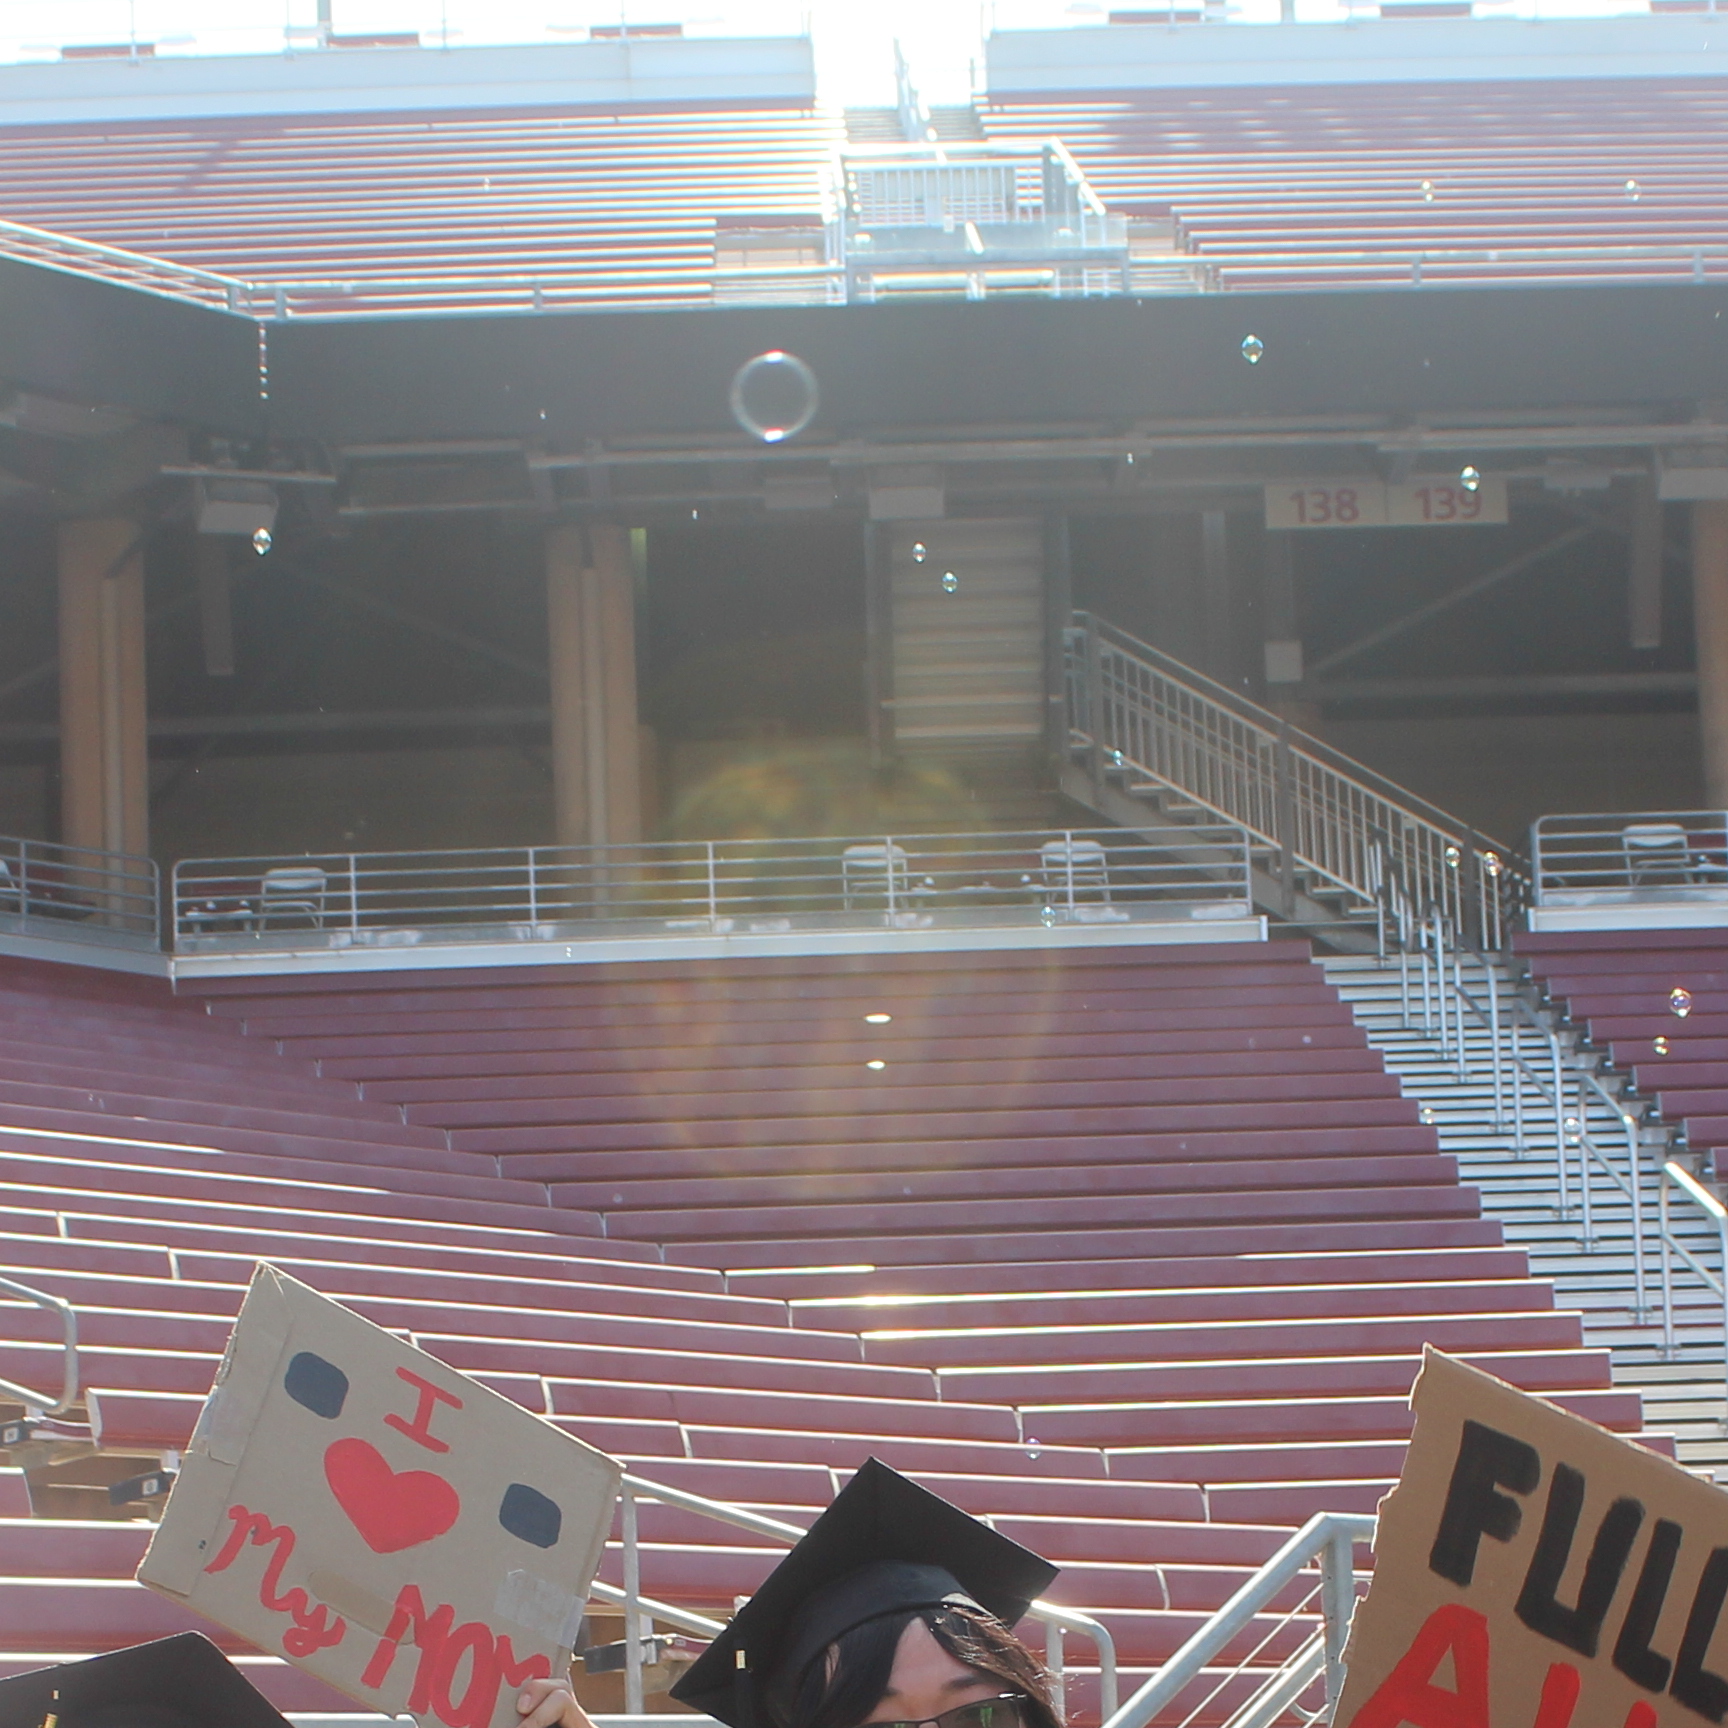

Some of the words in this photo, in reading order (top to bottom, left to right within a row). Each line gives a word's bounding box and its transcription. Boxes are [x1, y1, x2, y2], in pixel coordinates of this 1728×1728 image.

[1288, 487, 1361, 523] 138
[1412, 486, 1483, 521] 139
[383, 1366, 463, 1453] I
